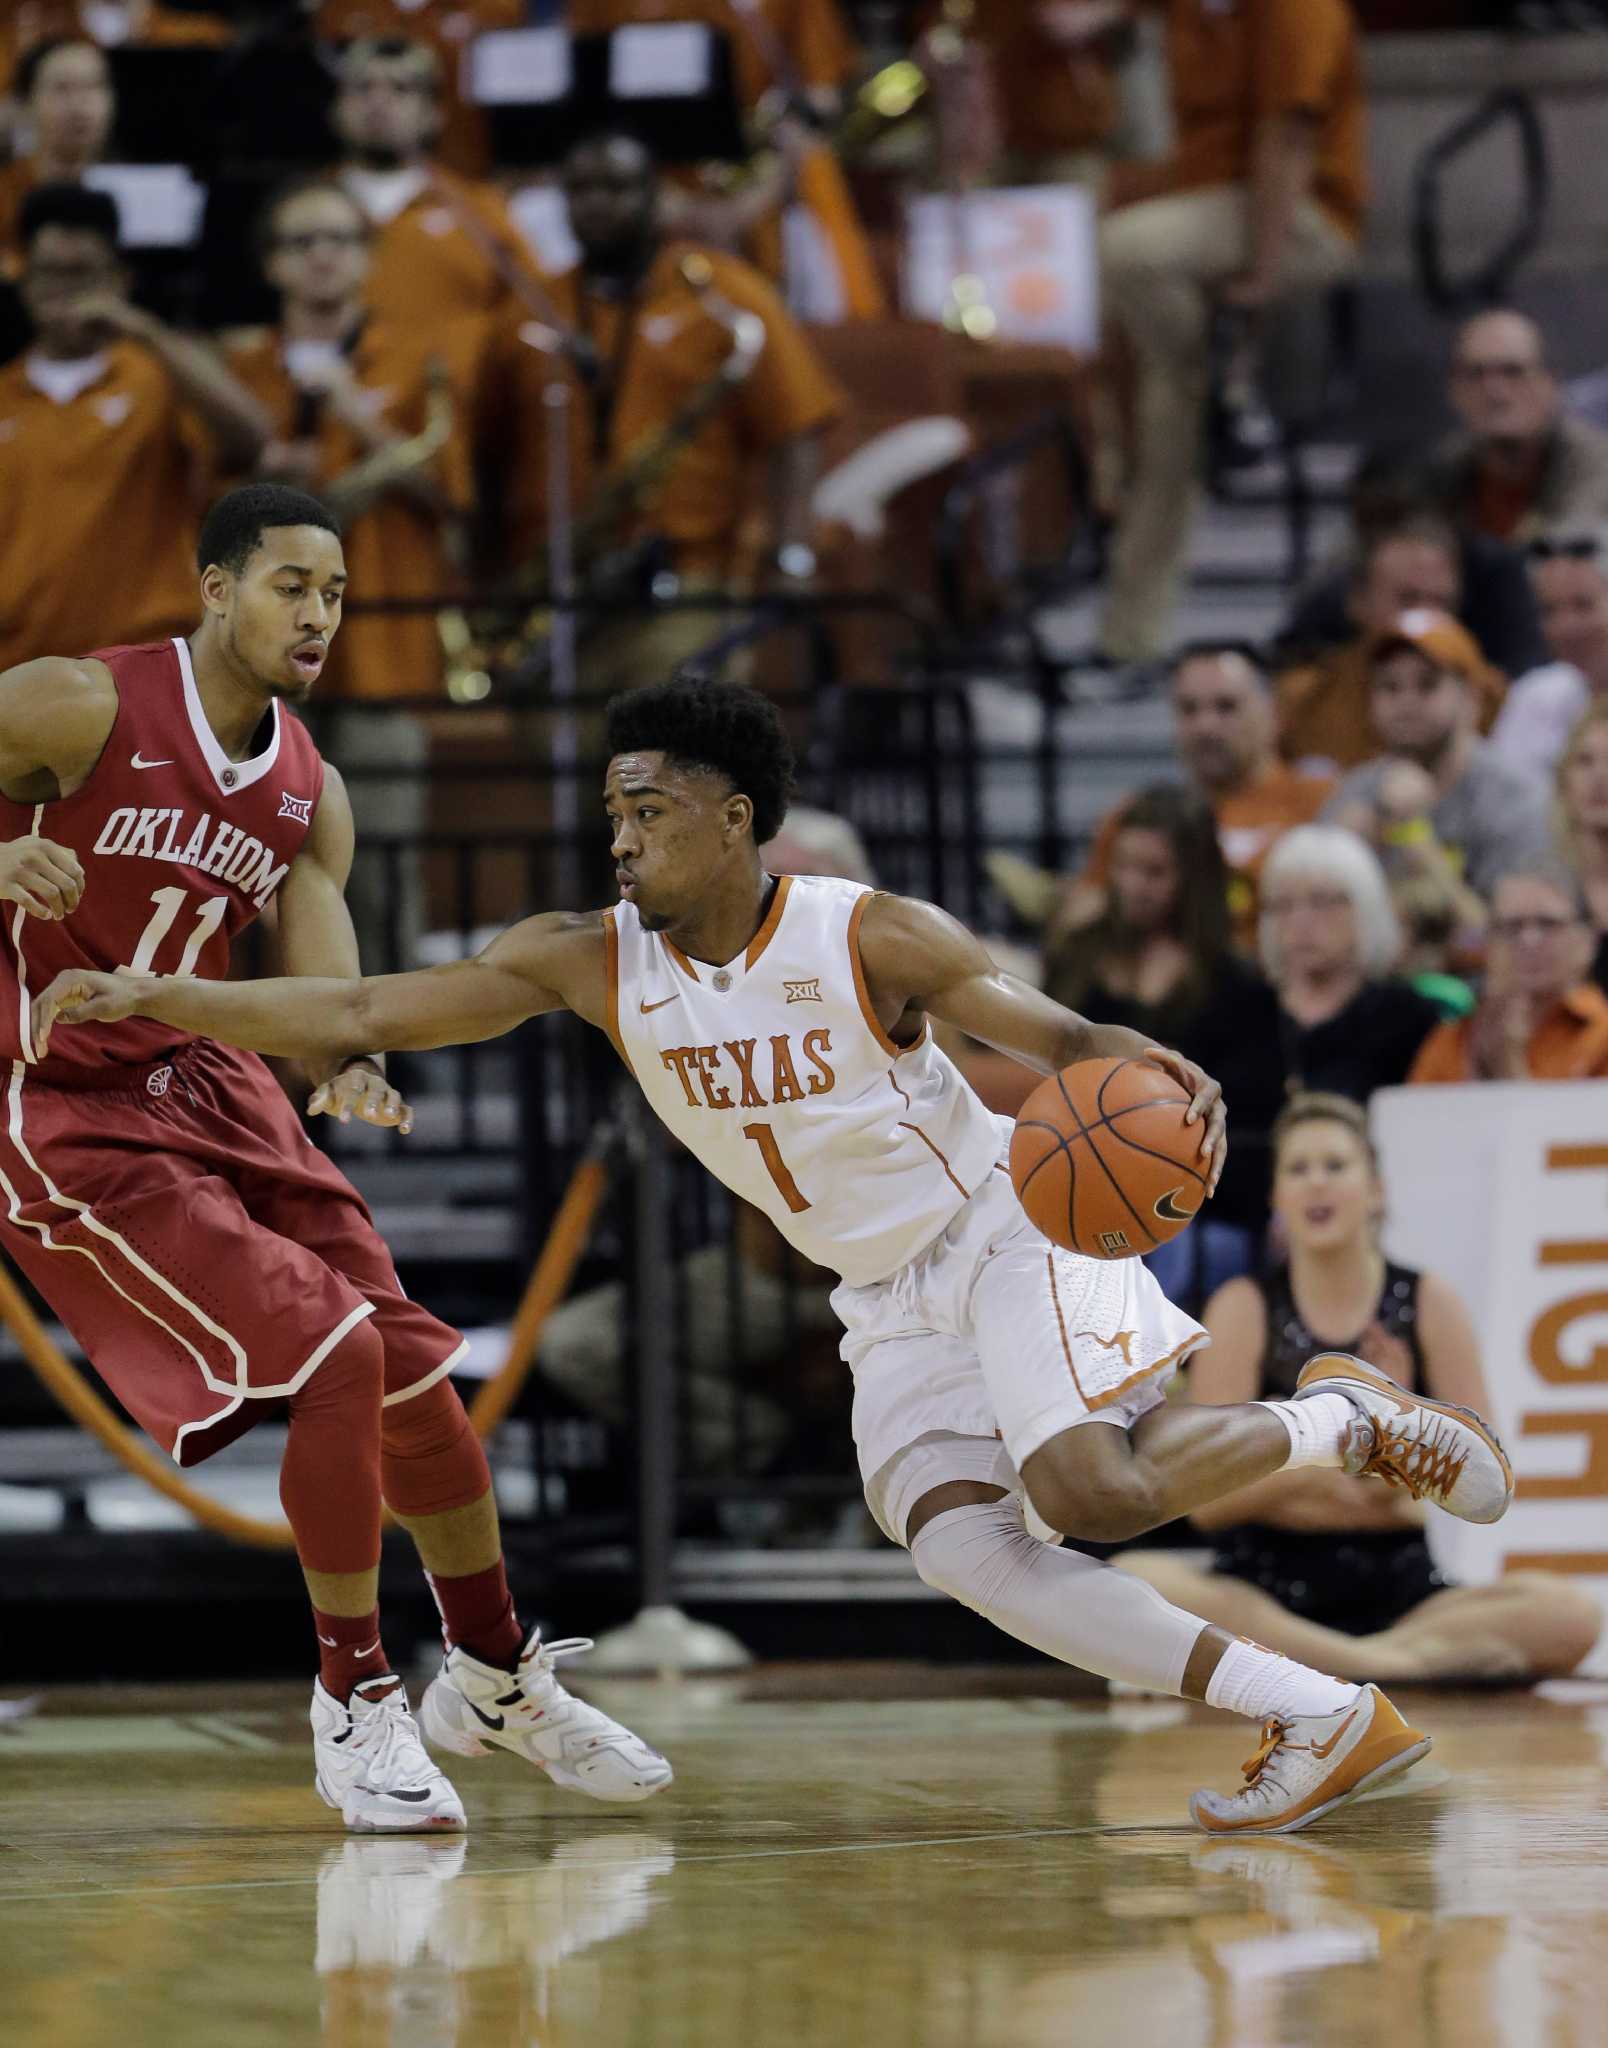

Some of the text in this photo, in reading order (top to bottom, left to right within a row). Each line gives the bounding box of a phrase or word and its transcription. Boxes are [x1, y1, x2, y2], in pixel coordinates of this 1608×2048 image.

[93, 807, 290, 911] OKLAHOM
[112, 886, 228, 978] 11
[659, 1028, 836, 1109] TEXAS
[743, 1123, 812, 1213] 1
